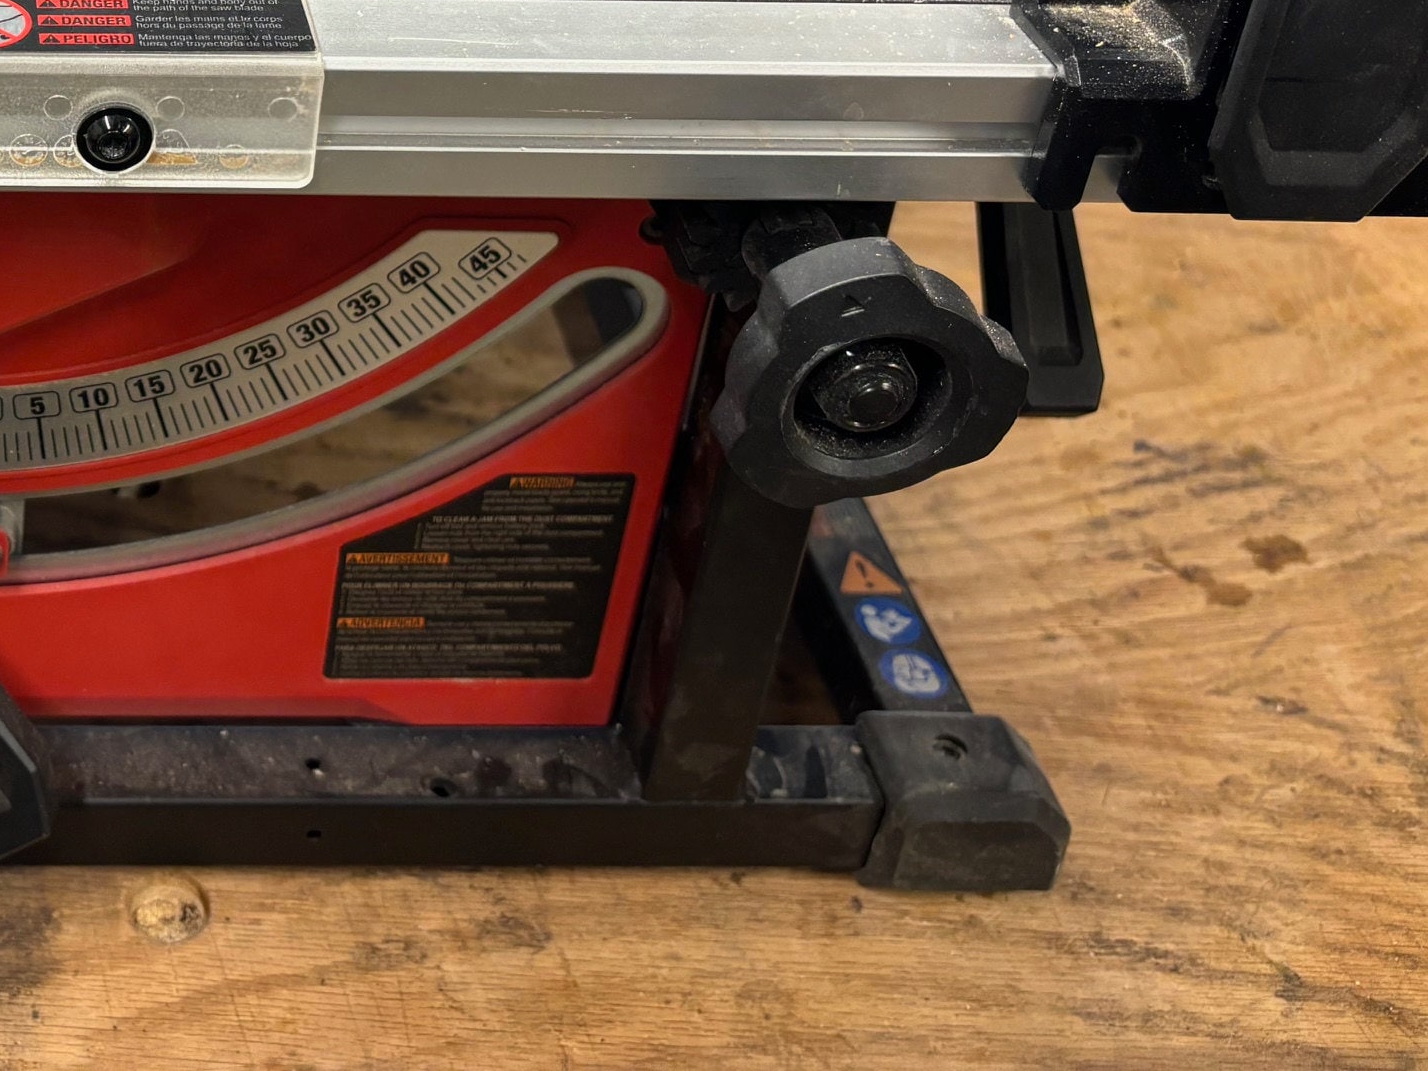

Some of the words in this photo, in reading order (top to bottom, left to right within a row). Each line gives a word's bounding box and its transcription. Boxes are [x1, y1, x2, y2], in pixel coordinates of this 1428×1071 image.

[59, 0, 124, 8] DANGER
[61, 16, 126, 25] DANGER
[63, 34, 132, 44] PELIGRO
[138, 33, 193, 41] Mantenga
[28, 395, 45, 415] 5
[76, 386, 111, 409] 10
[132, 374, 166, 398] 15
[187, 359, 224, 383] 20
[242, 339, 279, 365] 25
[294, 316, 332, 343] 30
[345, 290, 383, 319] 35
[396, 259, 432, 288] 40
[468, 242, 504, 274] 45
